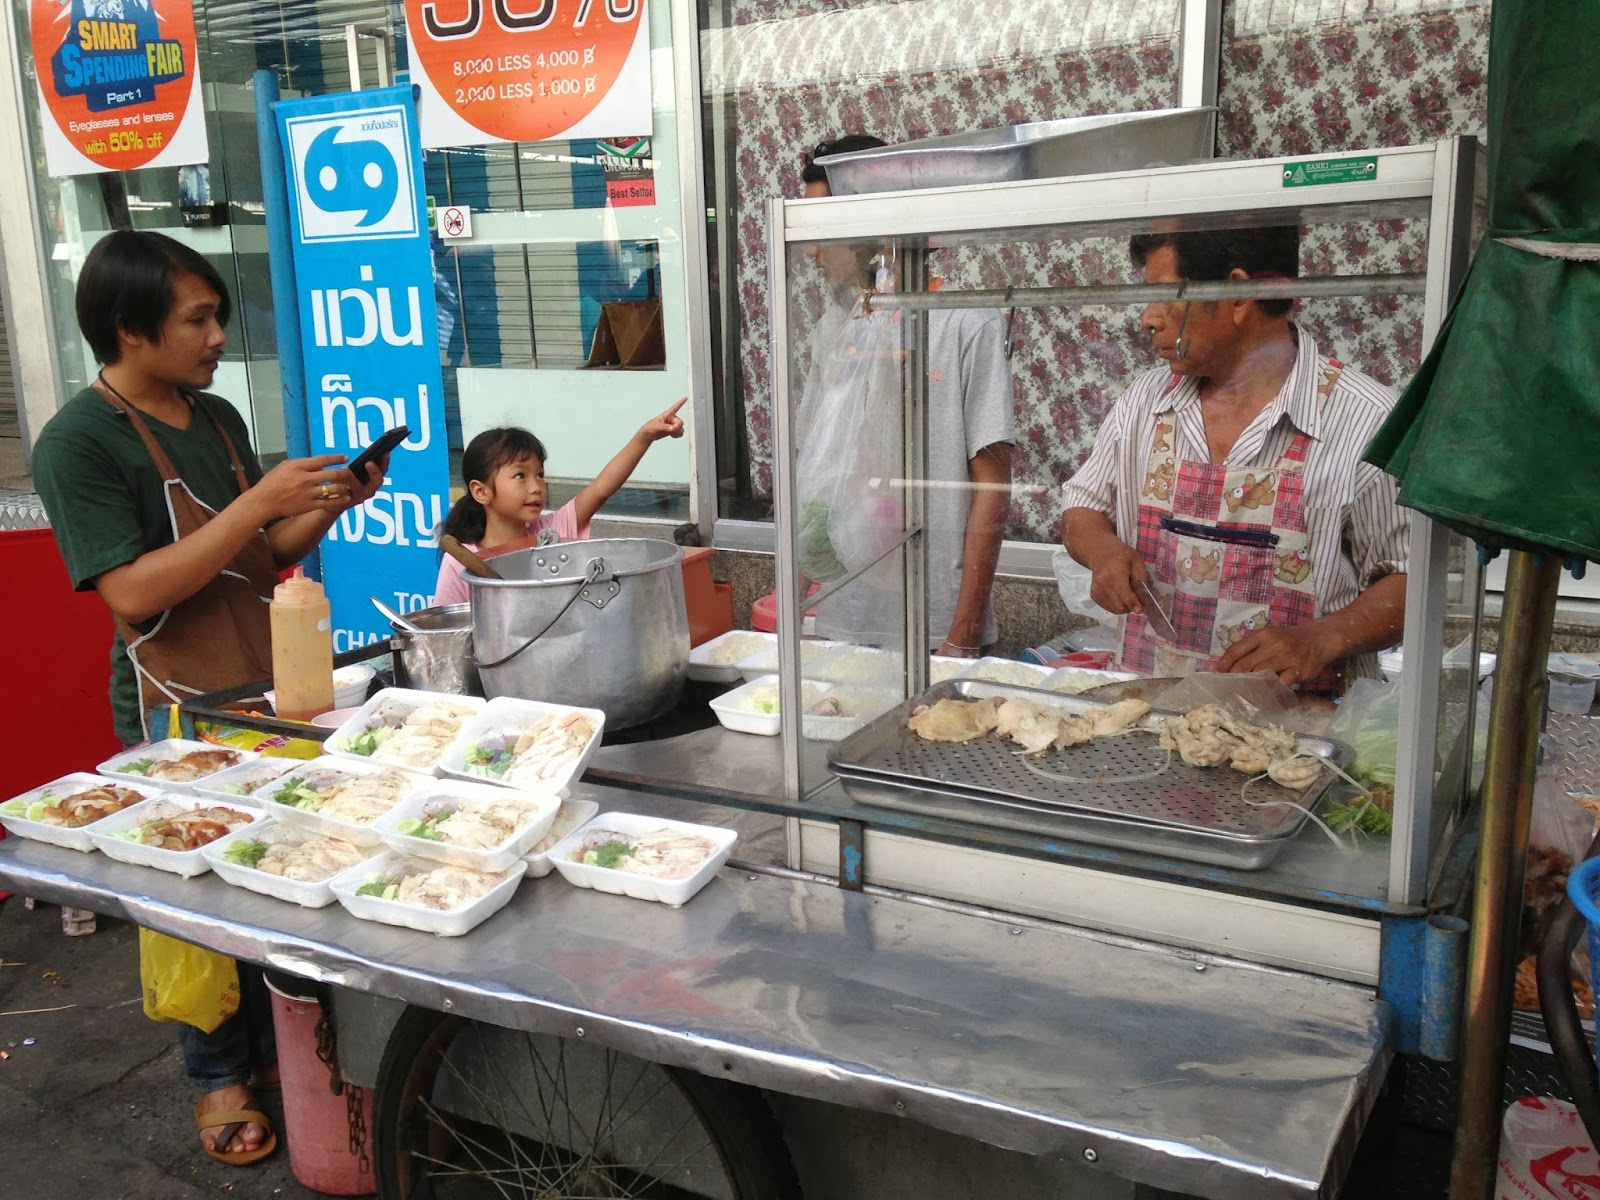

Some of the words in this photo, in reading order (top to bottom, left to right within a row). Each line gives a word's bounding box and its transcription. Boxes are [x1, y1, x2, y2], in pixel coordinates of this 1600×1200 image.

[78, 20, 137, 50] SMART
[61, 44, 147, 88] SPENDING
[145, 43, 183, 76] FAIR
[453, 57, 493, 77] 8,000
[497, 54, 531, 72] LESS
[536, 50, 579, 69] 4,000
[107, 92, 134, 104] Part
[135, 89, 142, 99] 1
[455, 86, 495, 104] 2,000
[500, 82, 533, 99] LESS
[538, 78, 580, 96] 1,000
[69, 116, 120, 133] Eyeglasses
[123, 113, 141, 126] and
[143, 111, 174, 123] lenses
[84, 140, 107, 155] with
[109, 131, 143, 152] 50%
[147, 132, 163, 148] off
[1306, 162, 1329, 170] SANKI
[610, 188, 628, 199] Best
[630, 186, 653, 198] Seller
[311, 265, 424, 347] แว่น
[321, 374, 431, 452] ท็อป
